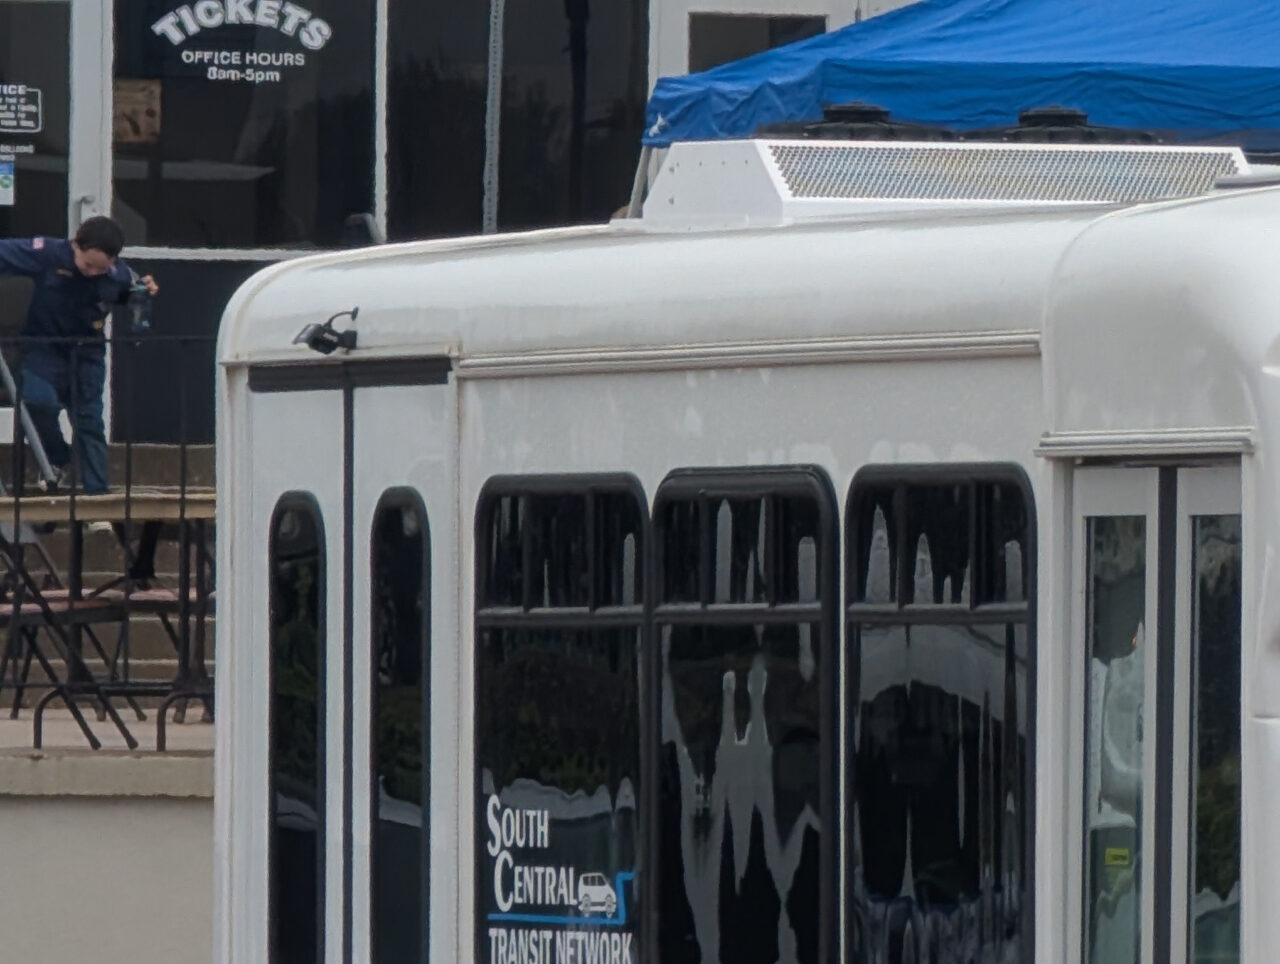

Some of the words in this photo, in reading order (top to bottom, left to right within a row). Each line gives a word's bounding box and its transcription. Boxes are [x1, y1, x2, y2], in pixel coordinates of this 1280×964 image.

[150, 0, 333, 50] TICKETS
[181, 50, 242, 64] OFFICE
[245, 52, 306, 66] HOURS
[207, 67, 281, 83] 8am-5pm
[487, 794, 550, 857] SOUTH
[494, 850, 578, 912] CENTRAL
